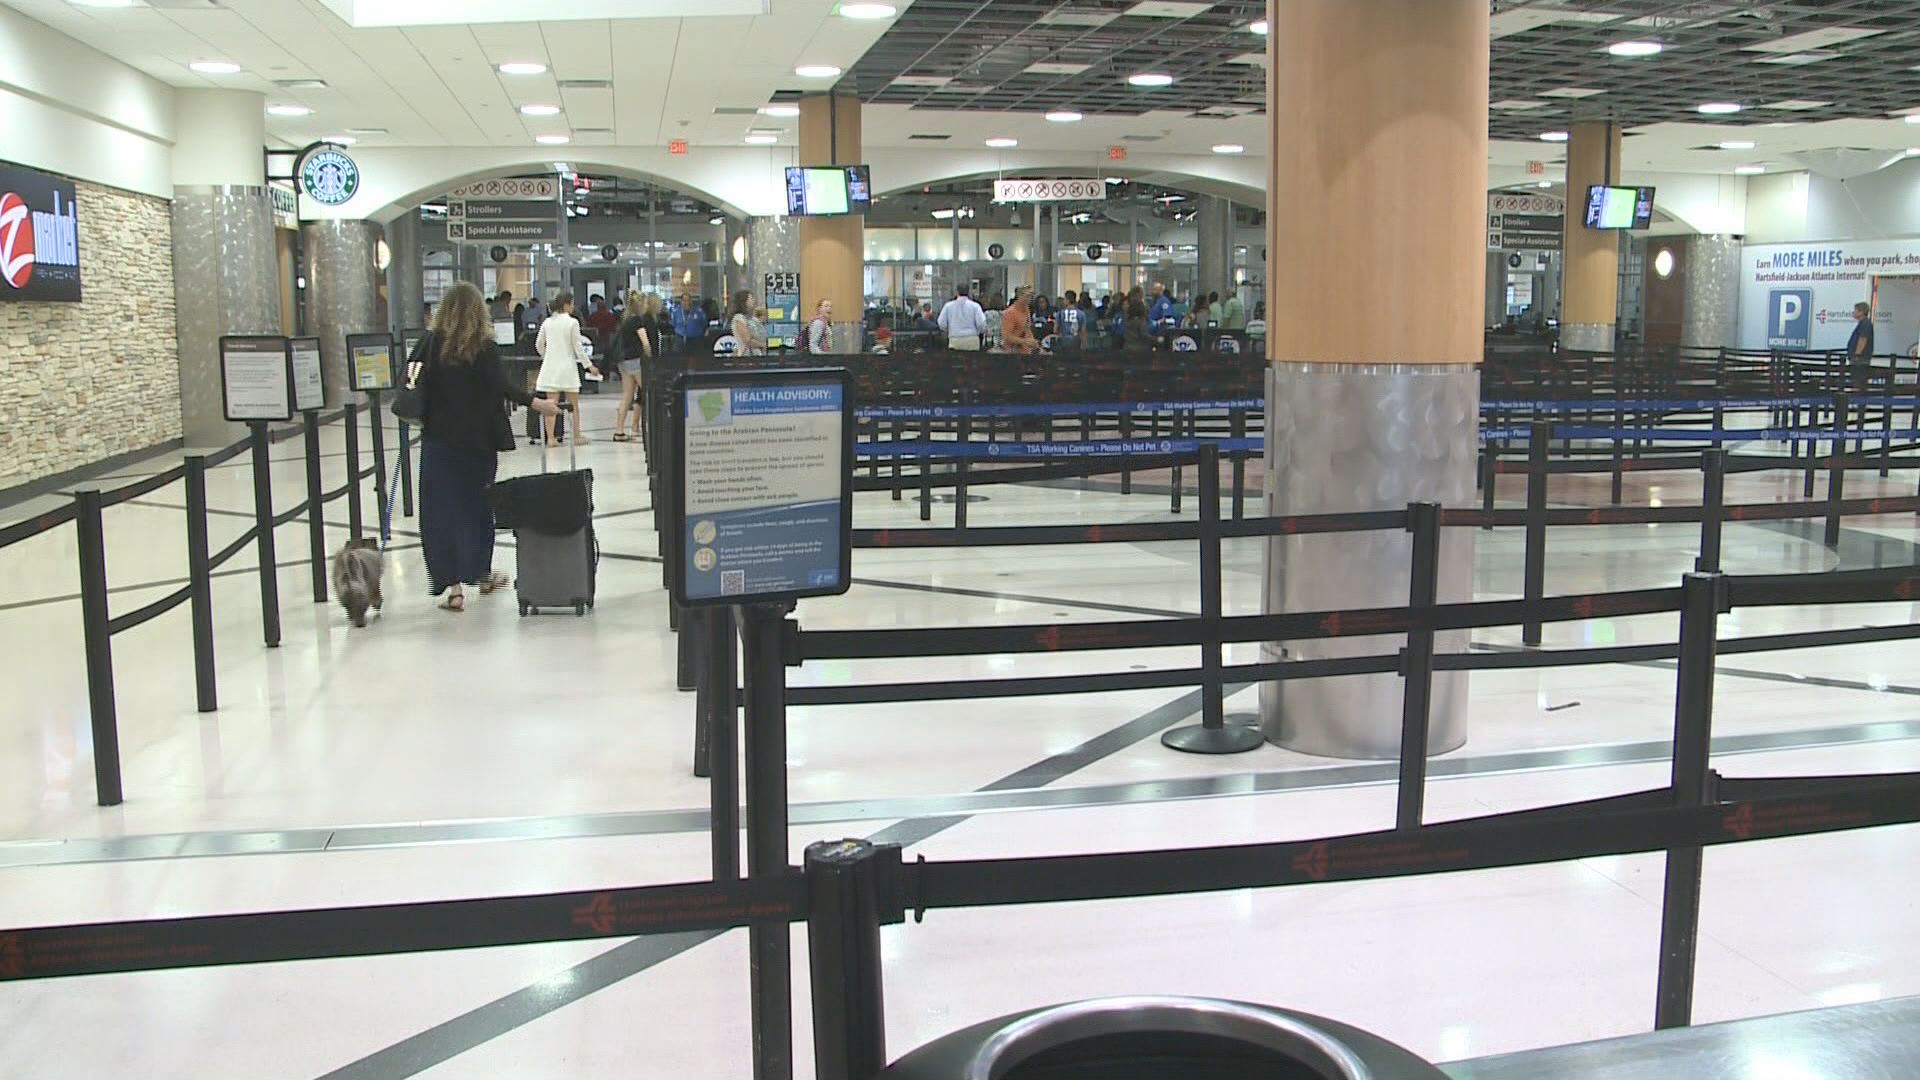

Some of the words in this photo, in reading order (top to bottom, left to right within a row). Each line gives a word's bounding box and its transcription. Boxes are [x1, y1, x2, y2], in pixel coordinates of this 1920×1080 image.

[305, 152, 355, 176] STARBUCKS
[467, 205, 502, 215] Strollers
[468, 225, 497, 236] Special
[499, 225, 543, 235] Assistance
[1756, 258, 1771, 269] Earn
[1773, 252, 1804, 268] MORE
[1807, 250, 1842, 267] MILES
[1844, 255, 1865, 266] when
[1866, 256, 1880, 267] you
[1882, 253, 1903, 267] park,
[1905, 253, 1920, 267] sho
[1811, 271, 1835, 281] Atlanta
[1064, 309, 1078, 322] 12
[1778, 294, 1802, 337] P
[734, 390, 775, 403] HEALTH
[776, 388, 832, 401] ADVISORY:
[1027, 445, 1041, 453] TSA
[1042, 445, 1068, 454] Working
[1069, 444, 1094, 453] Canines
[1100, 443, 1121, 452] Please
[1122, 443, 1132, 451] Do
[1133, 442, 1144, 451] Not
[1145, 442, 1156, 450] Pet
